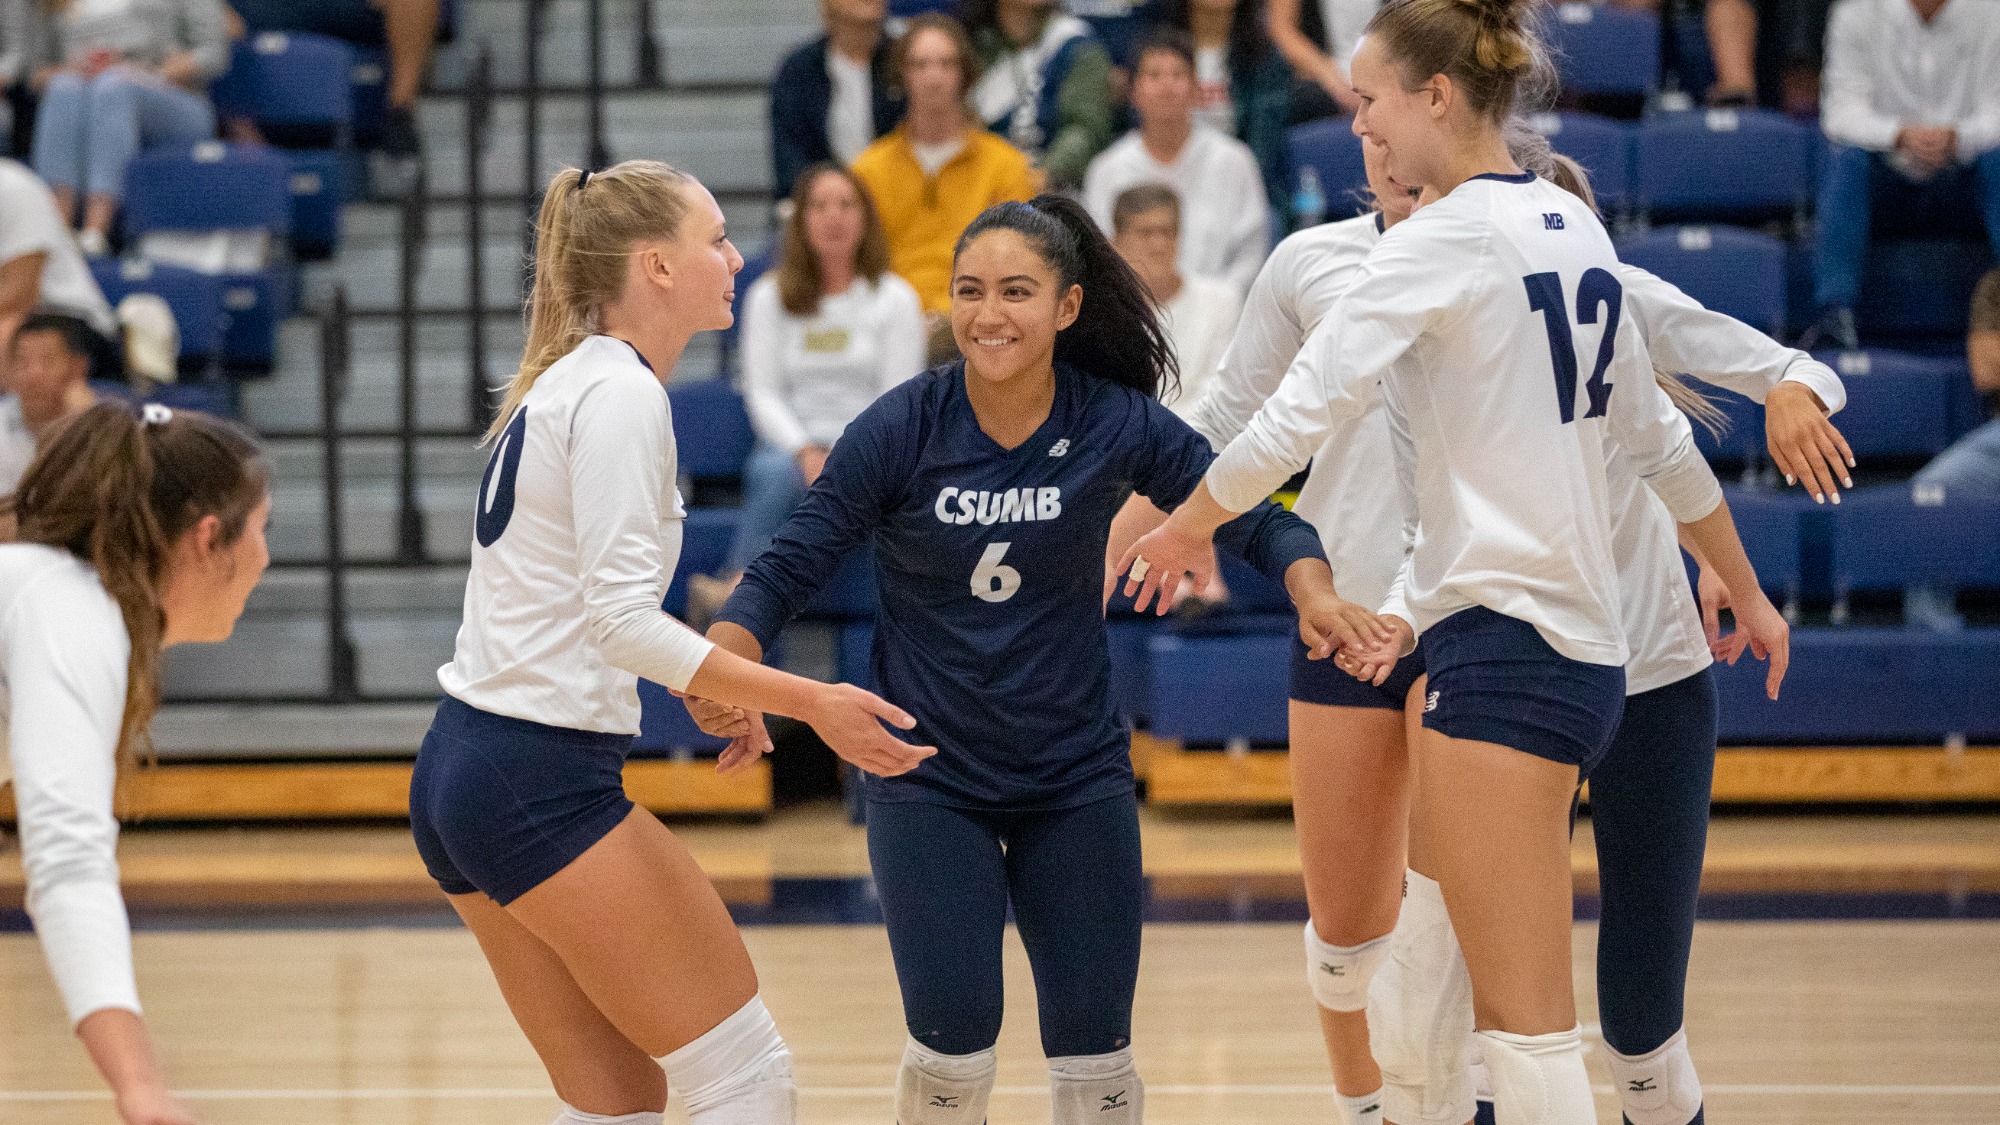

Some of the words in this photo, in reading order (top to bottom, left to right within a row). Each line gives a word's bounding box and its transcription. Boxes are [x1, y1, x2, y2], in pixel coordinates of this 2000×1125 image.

[1542, 212, 1565, 230] MB
[1522, 267, 1622, 424] 12
[934, 486, 1062, 525] CSUMB
[970, 541, 1022, 603] 6
